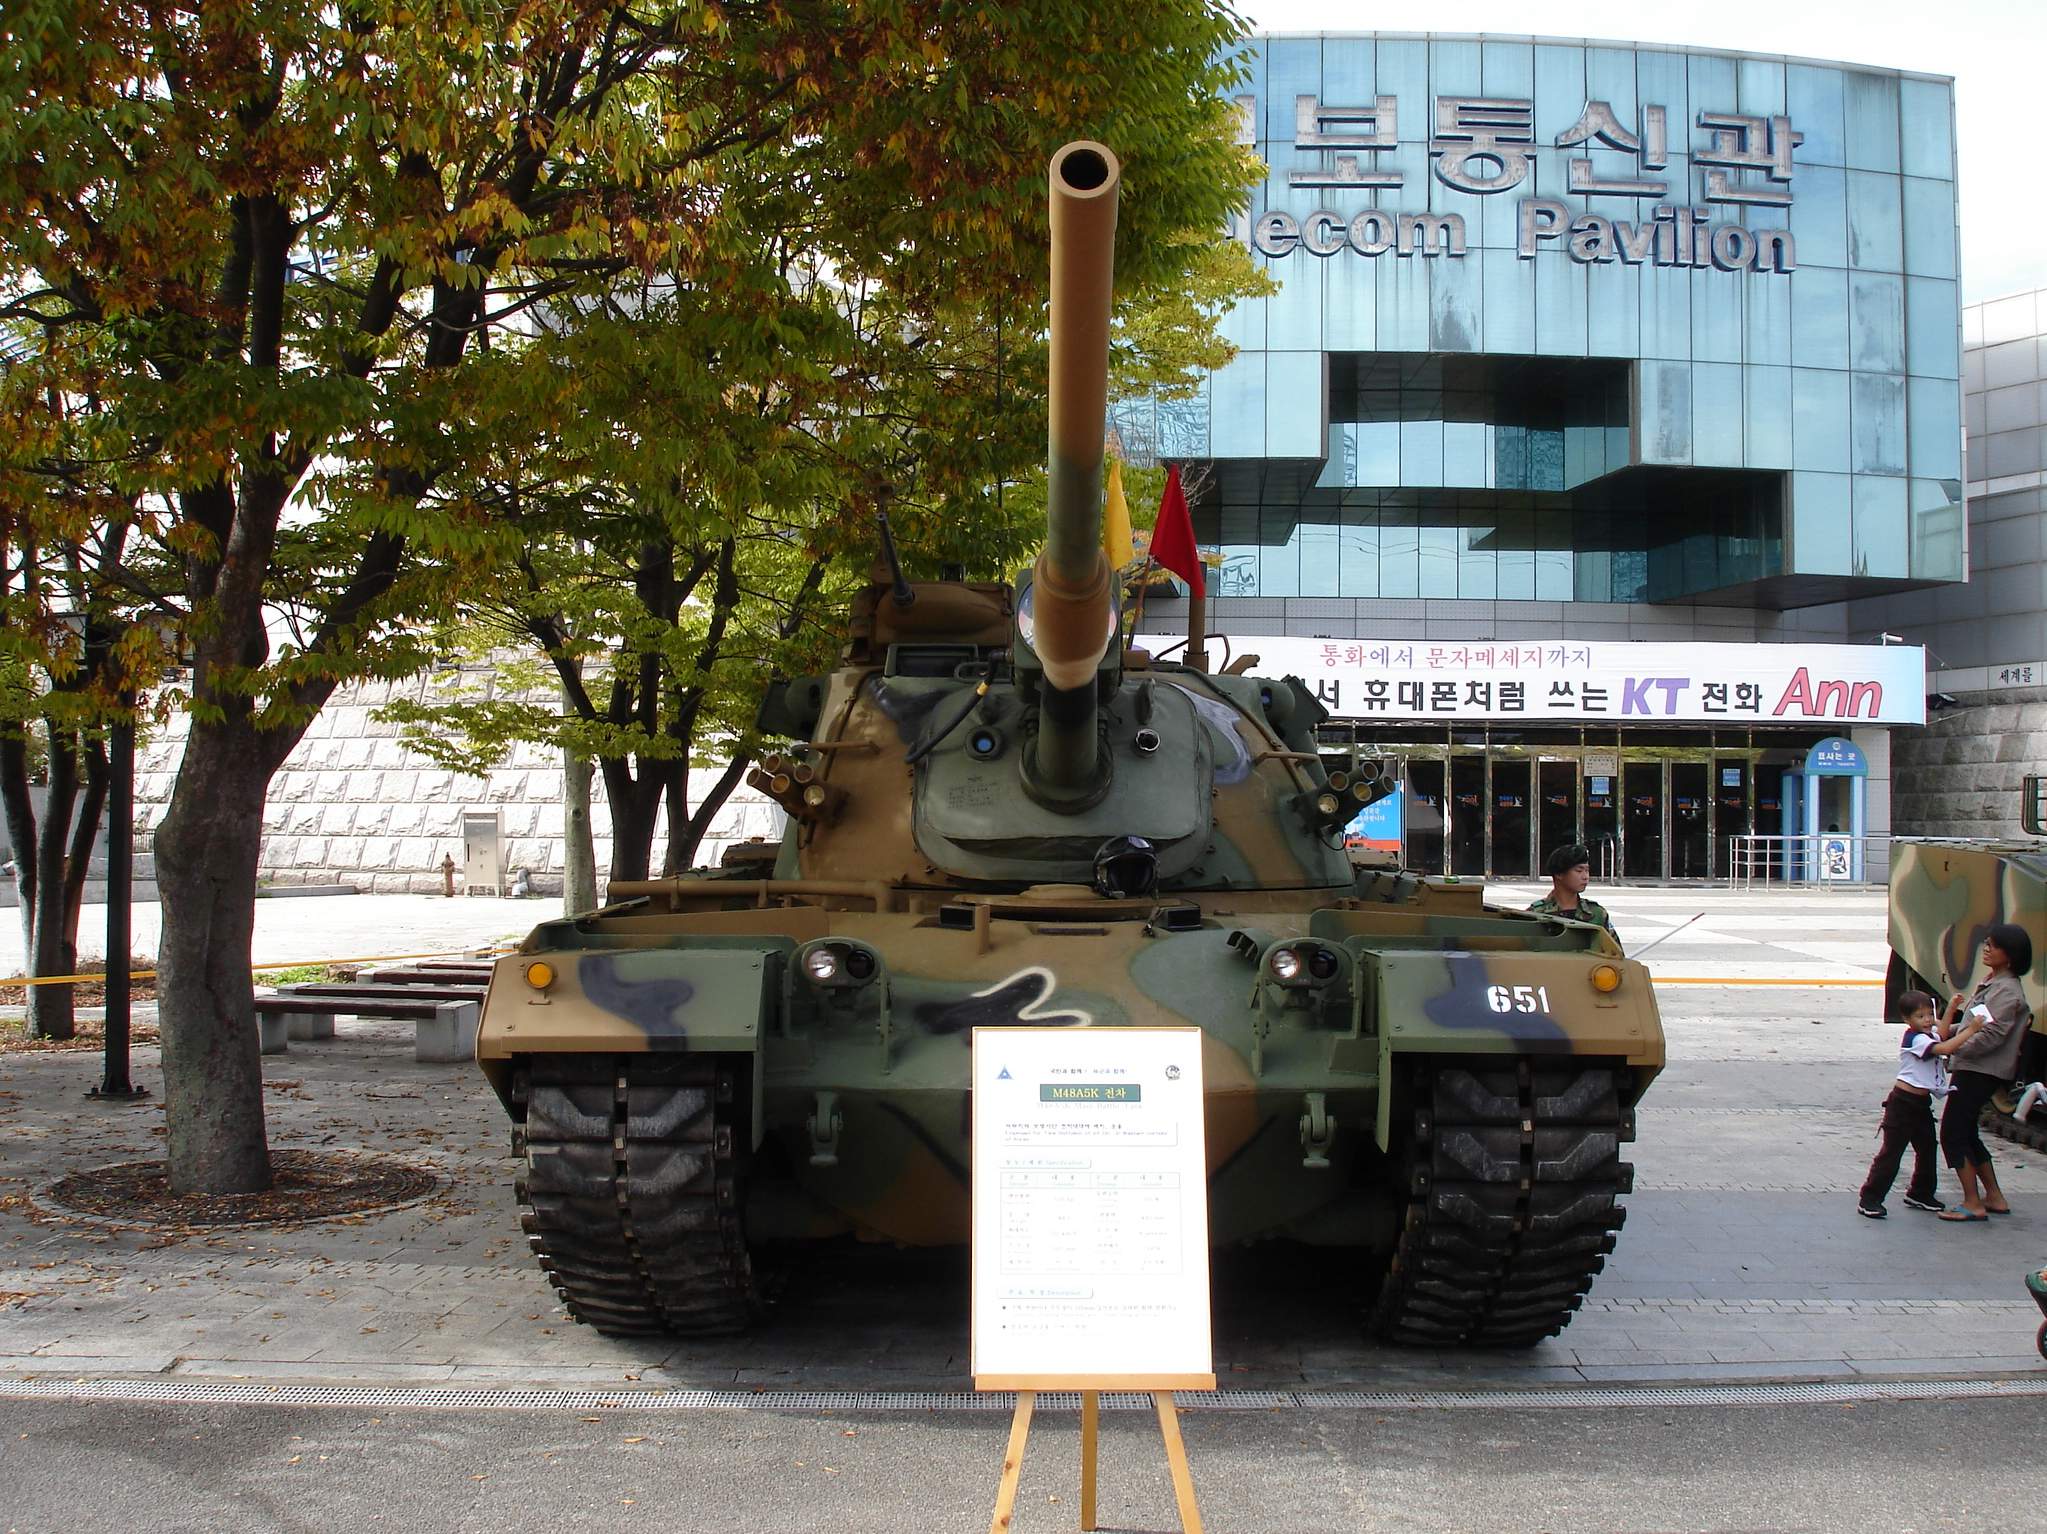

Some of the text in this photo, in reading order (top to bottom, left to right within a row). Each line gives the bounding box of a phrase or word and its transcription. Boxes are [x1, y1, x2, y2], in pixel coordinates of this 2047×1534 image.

[1226, 200, 1797, 274] lecom Pavilion
[1320, 643, 1592, 670] 통화에서 문자메세지까지
[1999, 667, 2032, 684] 세계를
[1301, 667, 1883, 718] 서 휴대폰처럼 쓰는 KT 전화 Ann
[1487, 985, 1550, 1013] 651
[1053, 1087, 1126, 1099] M48A5K 전차
